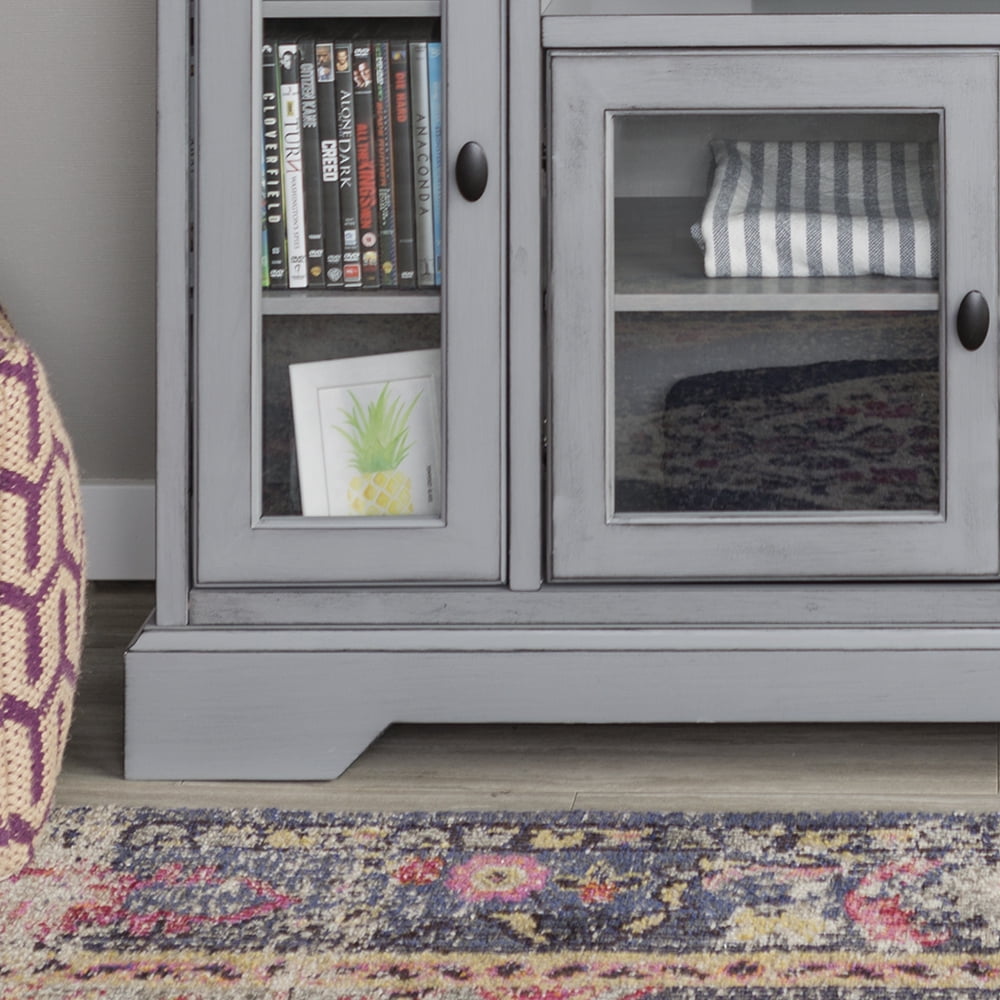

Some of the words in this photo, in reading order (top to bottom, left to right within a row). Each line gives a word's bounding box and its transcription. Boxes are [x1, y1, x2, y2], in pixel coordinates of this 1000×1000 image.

[395, 72, 407, 89] DIE
[339, 90, 352, 138] ALONE
[396, 92, 408, 123] HARD
[262, 92, 281, 224] CLOVERFIELD
[321, 139, 338, 182] CREED
[339, 138, 352, 189] DARK
[416, 113, 430, 216] ANACONDA
